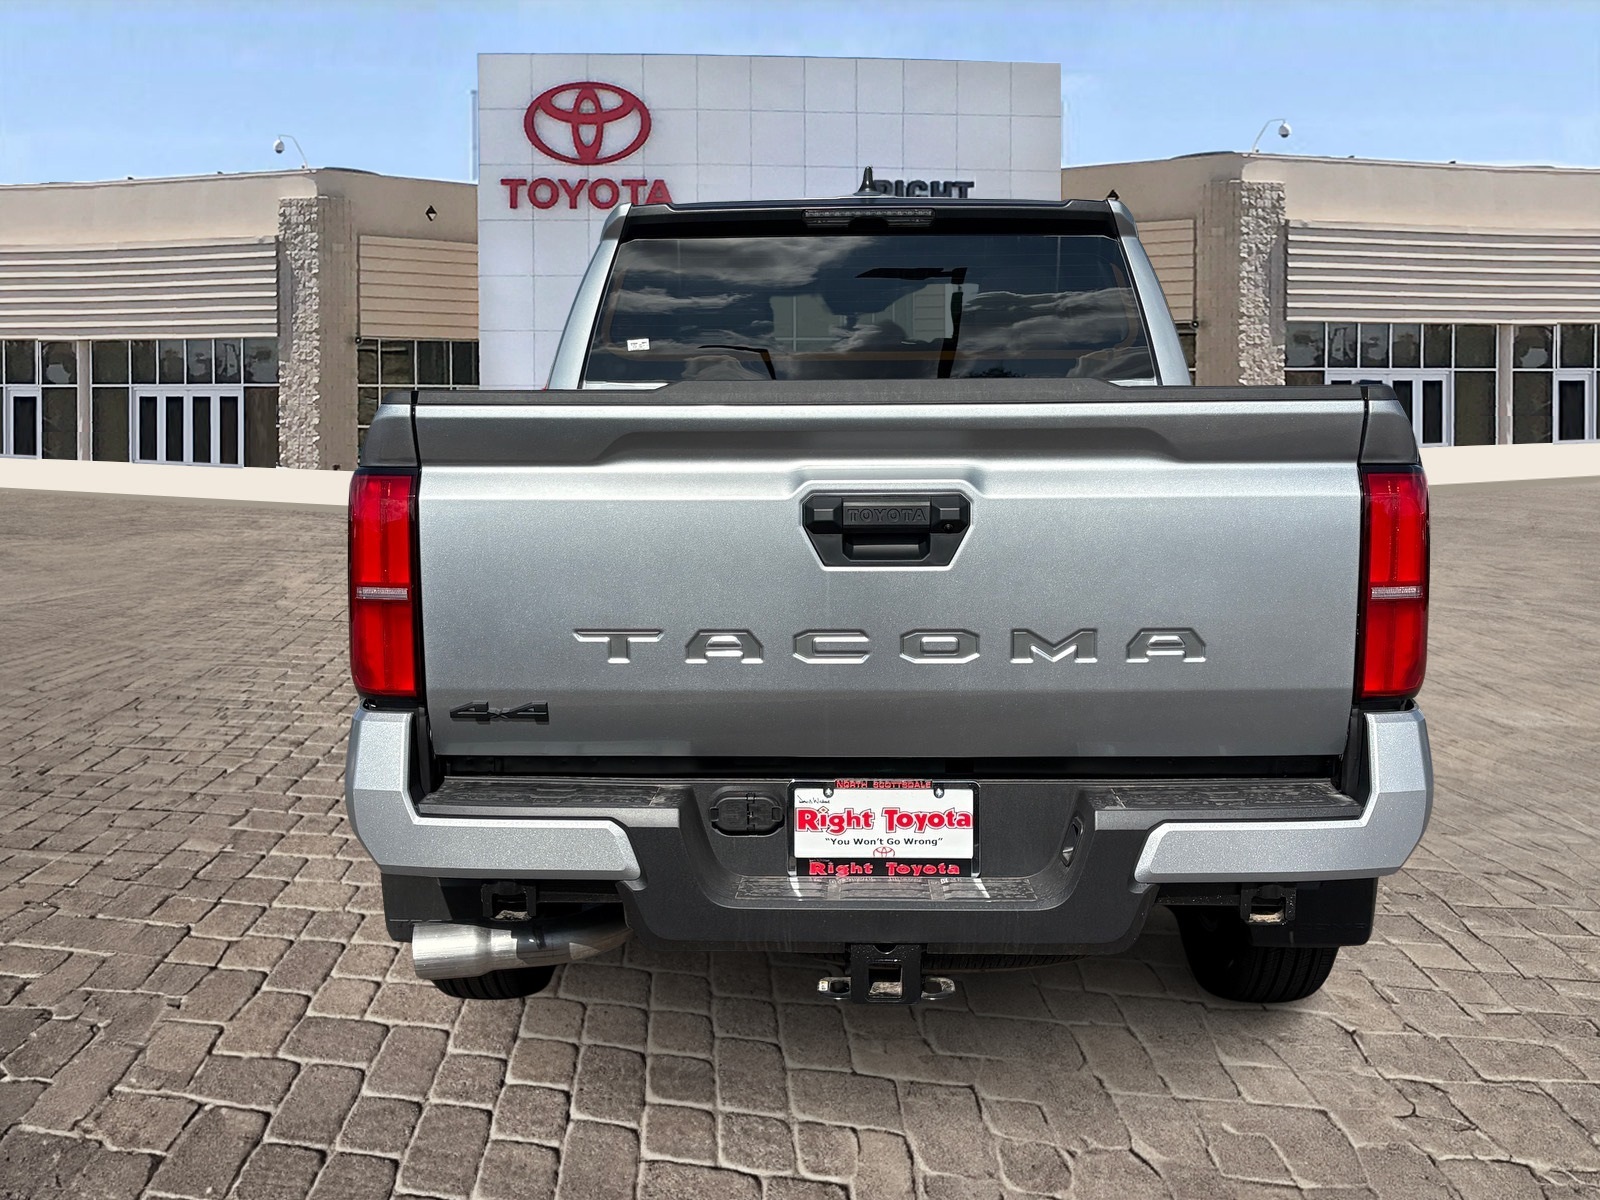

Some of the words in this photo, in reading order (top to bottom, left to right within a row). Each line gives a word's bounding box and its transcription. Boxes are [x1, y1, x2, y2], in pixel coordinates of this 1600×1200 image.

[500, 177, 673, 210] TOYOTA
[847, 508, 927, 523] TOYOTA
[573, 628, 1206, 664] TACOMA
[836, 780, 868, 788] NORTH
[873, 780, 932, 788] SCOTTSDALE
[796, 806, 875, 835] Right
[881, 807, 973, 833] Toyota
[854, 837, 884, 846] Won't
[886, 837, 901, 846] Go
[808, 861, 874, 877] Right
[885, 861, 961, 877] Toyota
